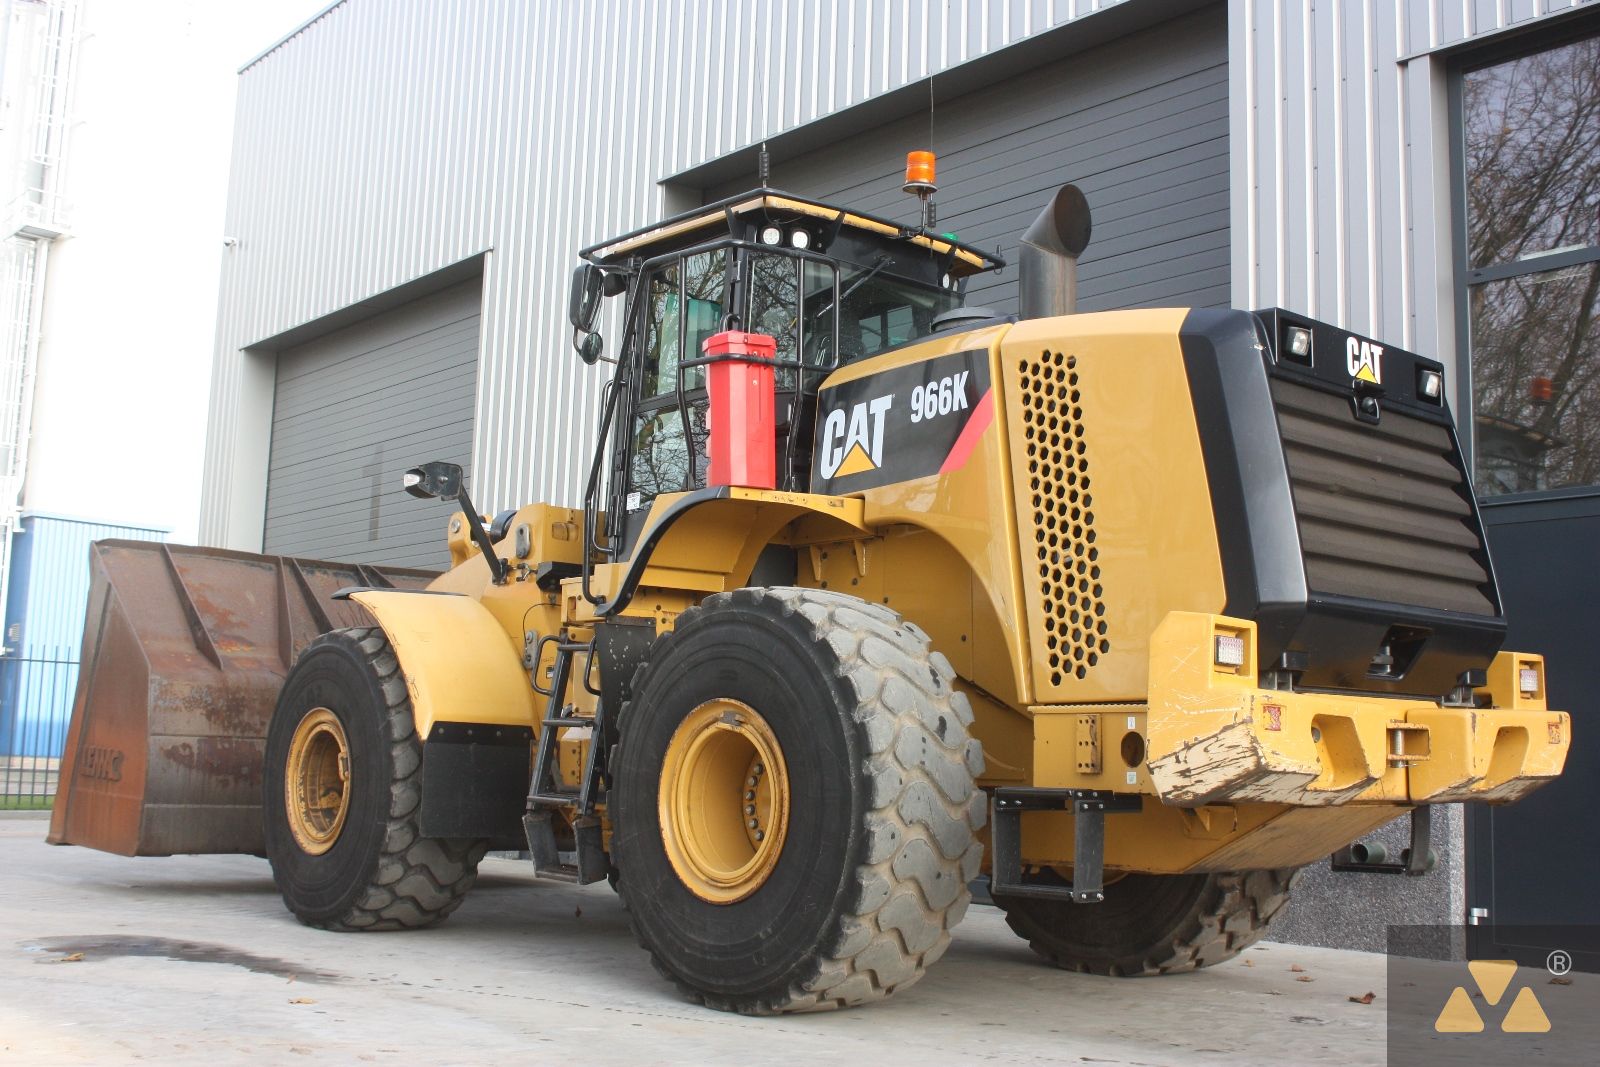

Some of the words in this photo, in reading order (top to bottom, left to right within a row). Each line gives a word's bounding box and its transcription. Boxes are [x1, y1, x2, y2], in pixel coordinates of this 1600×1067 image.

[1346, 336, 1383, 385] CAT
[910, 370, 969, 423] 966K
[820, 394, 892, 480] CAT
